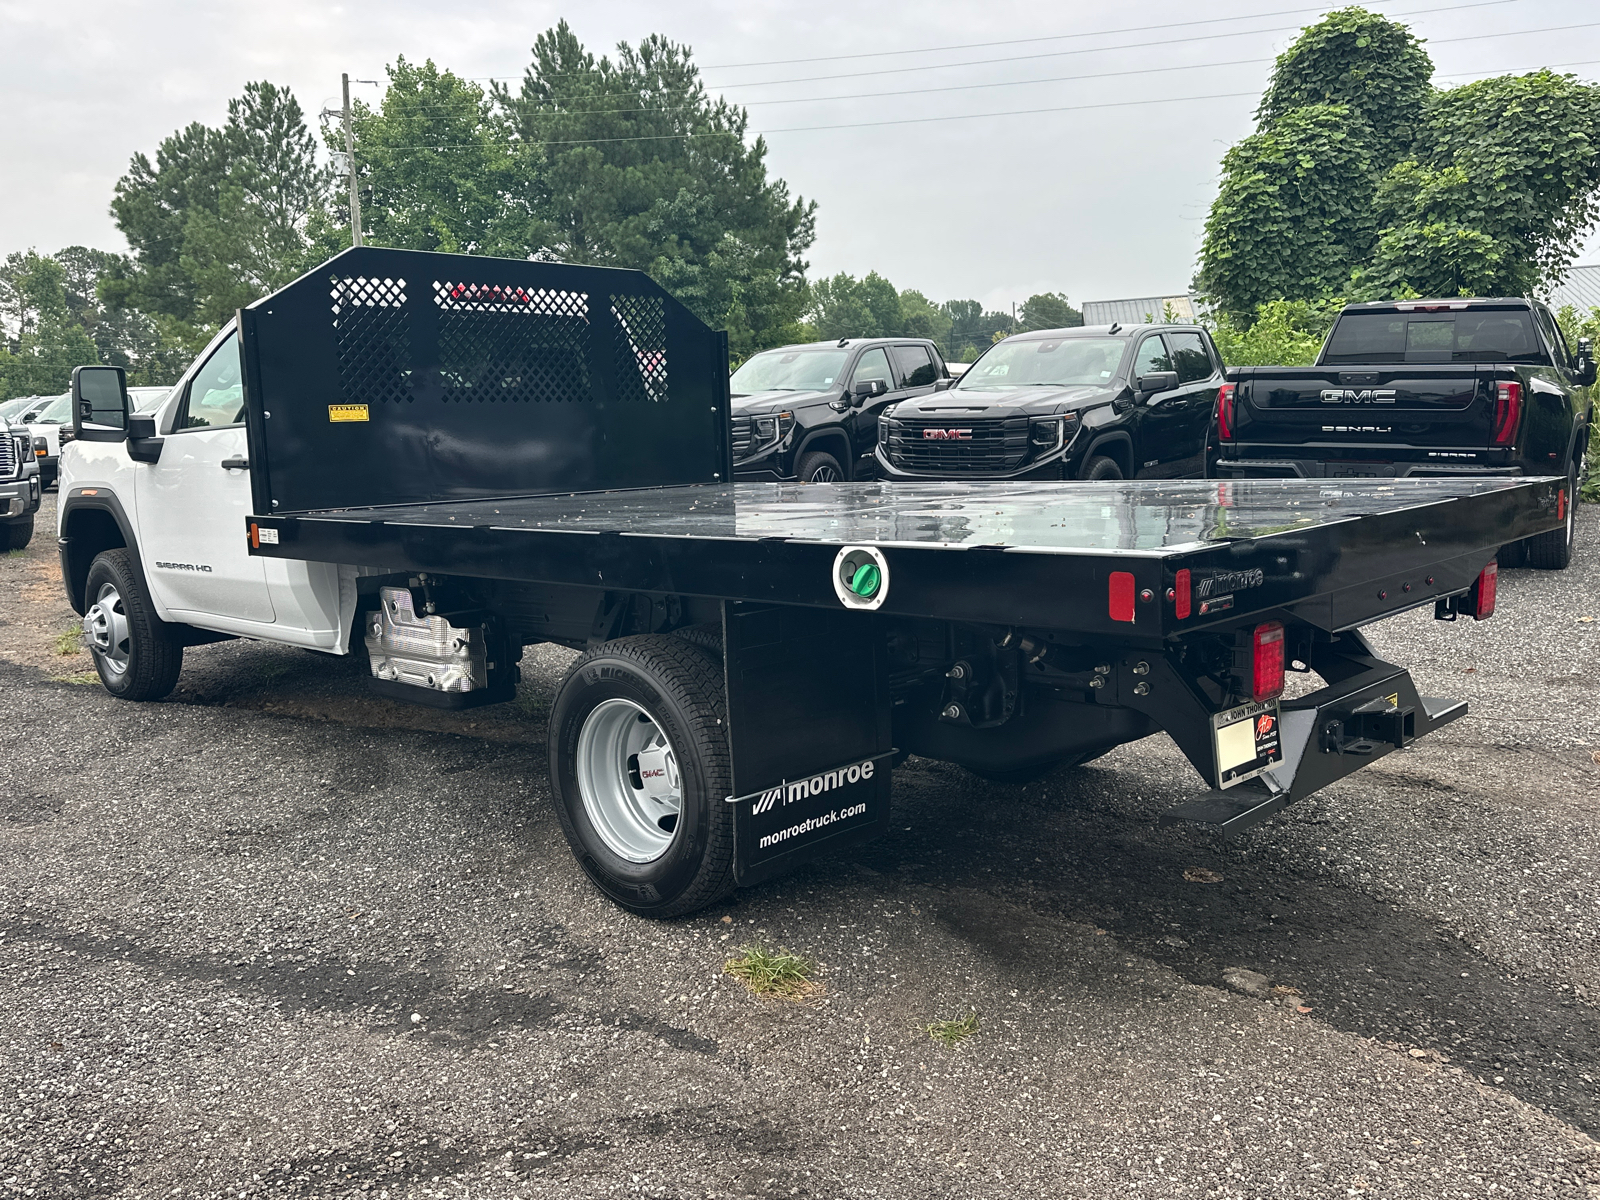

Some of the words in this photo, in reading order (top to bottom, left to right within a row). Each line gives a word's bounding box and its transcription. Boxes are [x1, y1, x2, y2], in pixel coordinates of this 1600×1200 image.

[1320, 389, 1397, 404] GMC
[923, 428, 973, 440] GMC
[1321, 425, 1392, 433] DENALI
[155, 561, 195, 571] SIERRA
[195, 564, 213, 573] HD
[1246, 699, 1277, 715] THORNON
[641, 768, 666, 779] GMC
[788, 760, 875, 804] monroe
[759, 802, 867, 849] monroetruck.com
